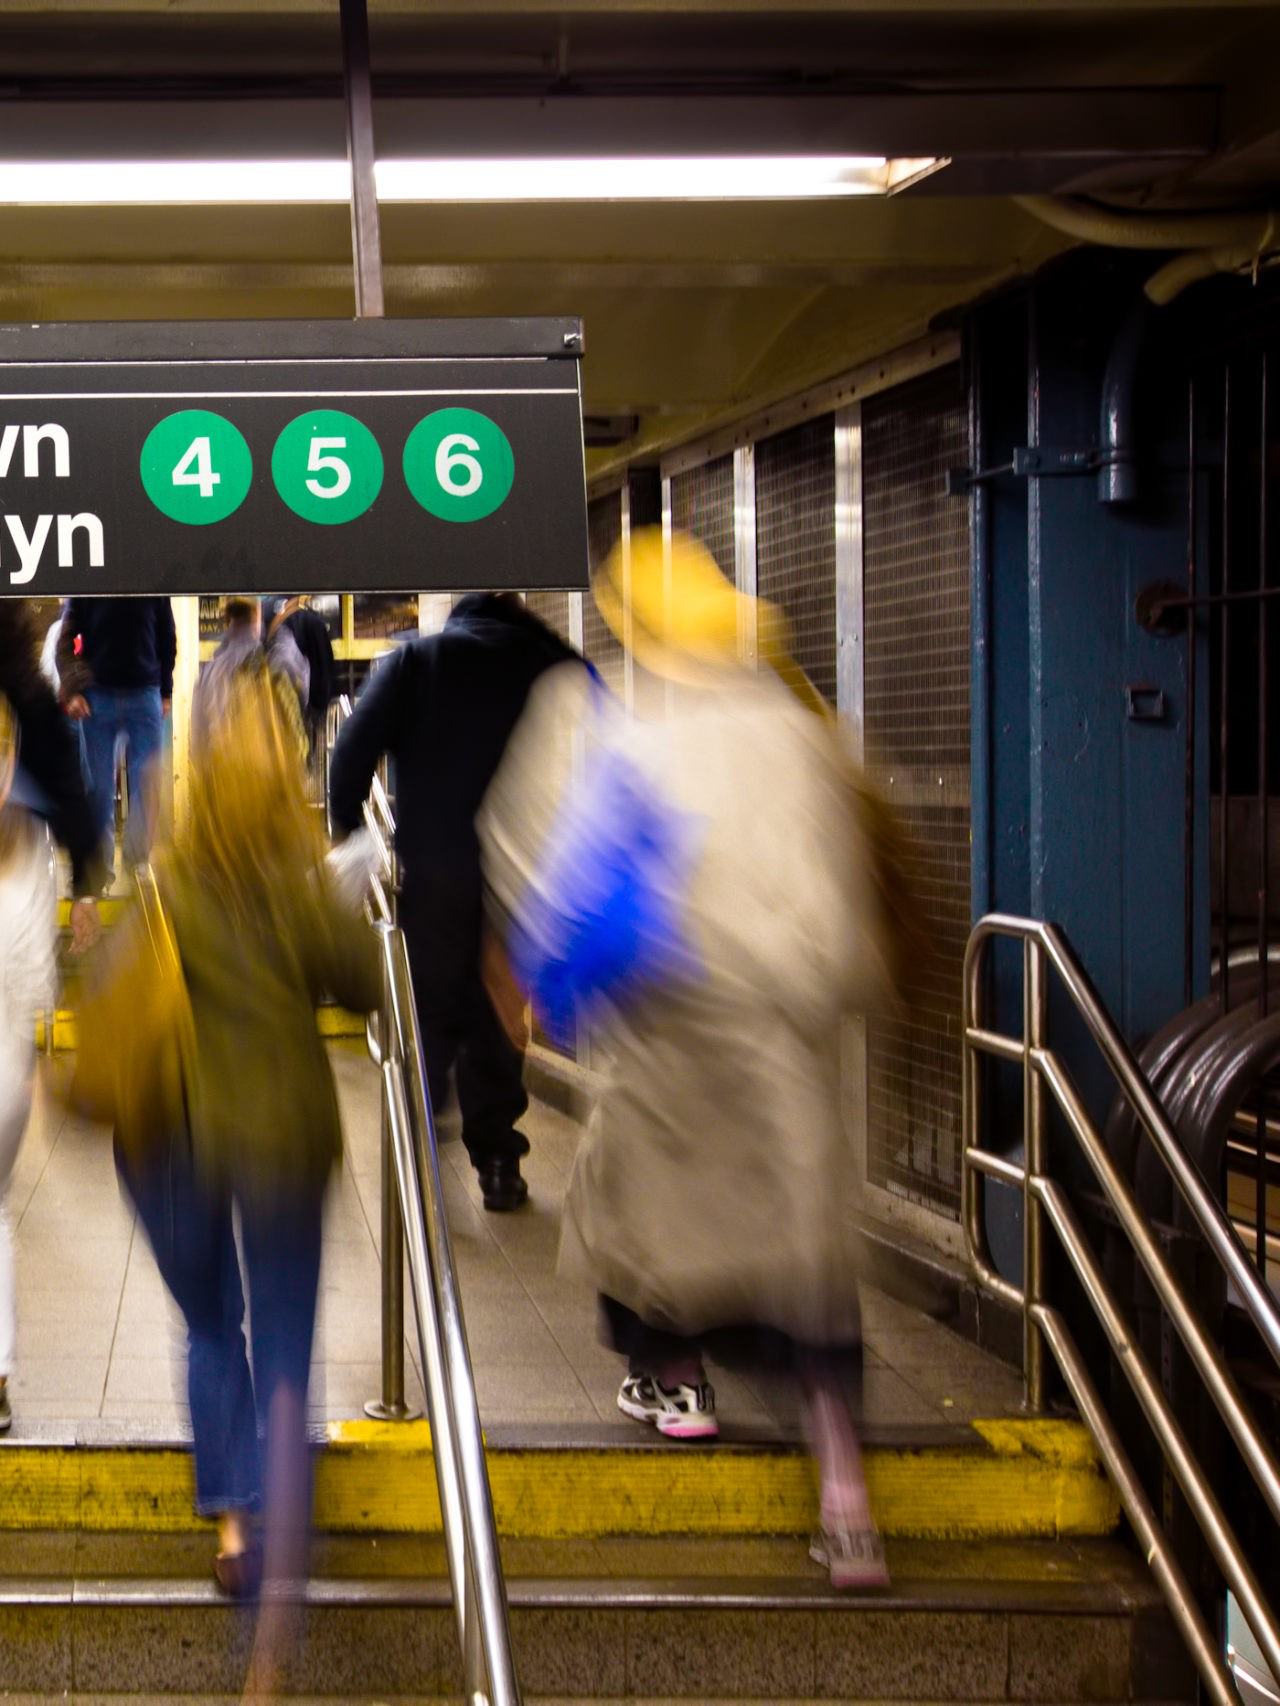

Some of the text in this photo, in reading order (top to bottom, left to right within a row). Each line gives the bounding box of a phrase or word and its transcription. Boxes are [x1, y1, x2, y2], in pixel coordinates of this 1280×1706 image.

[171, 433, 483, 499] 4 5 6
